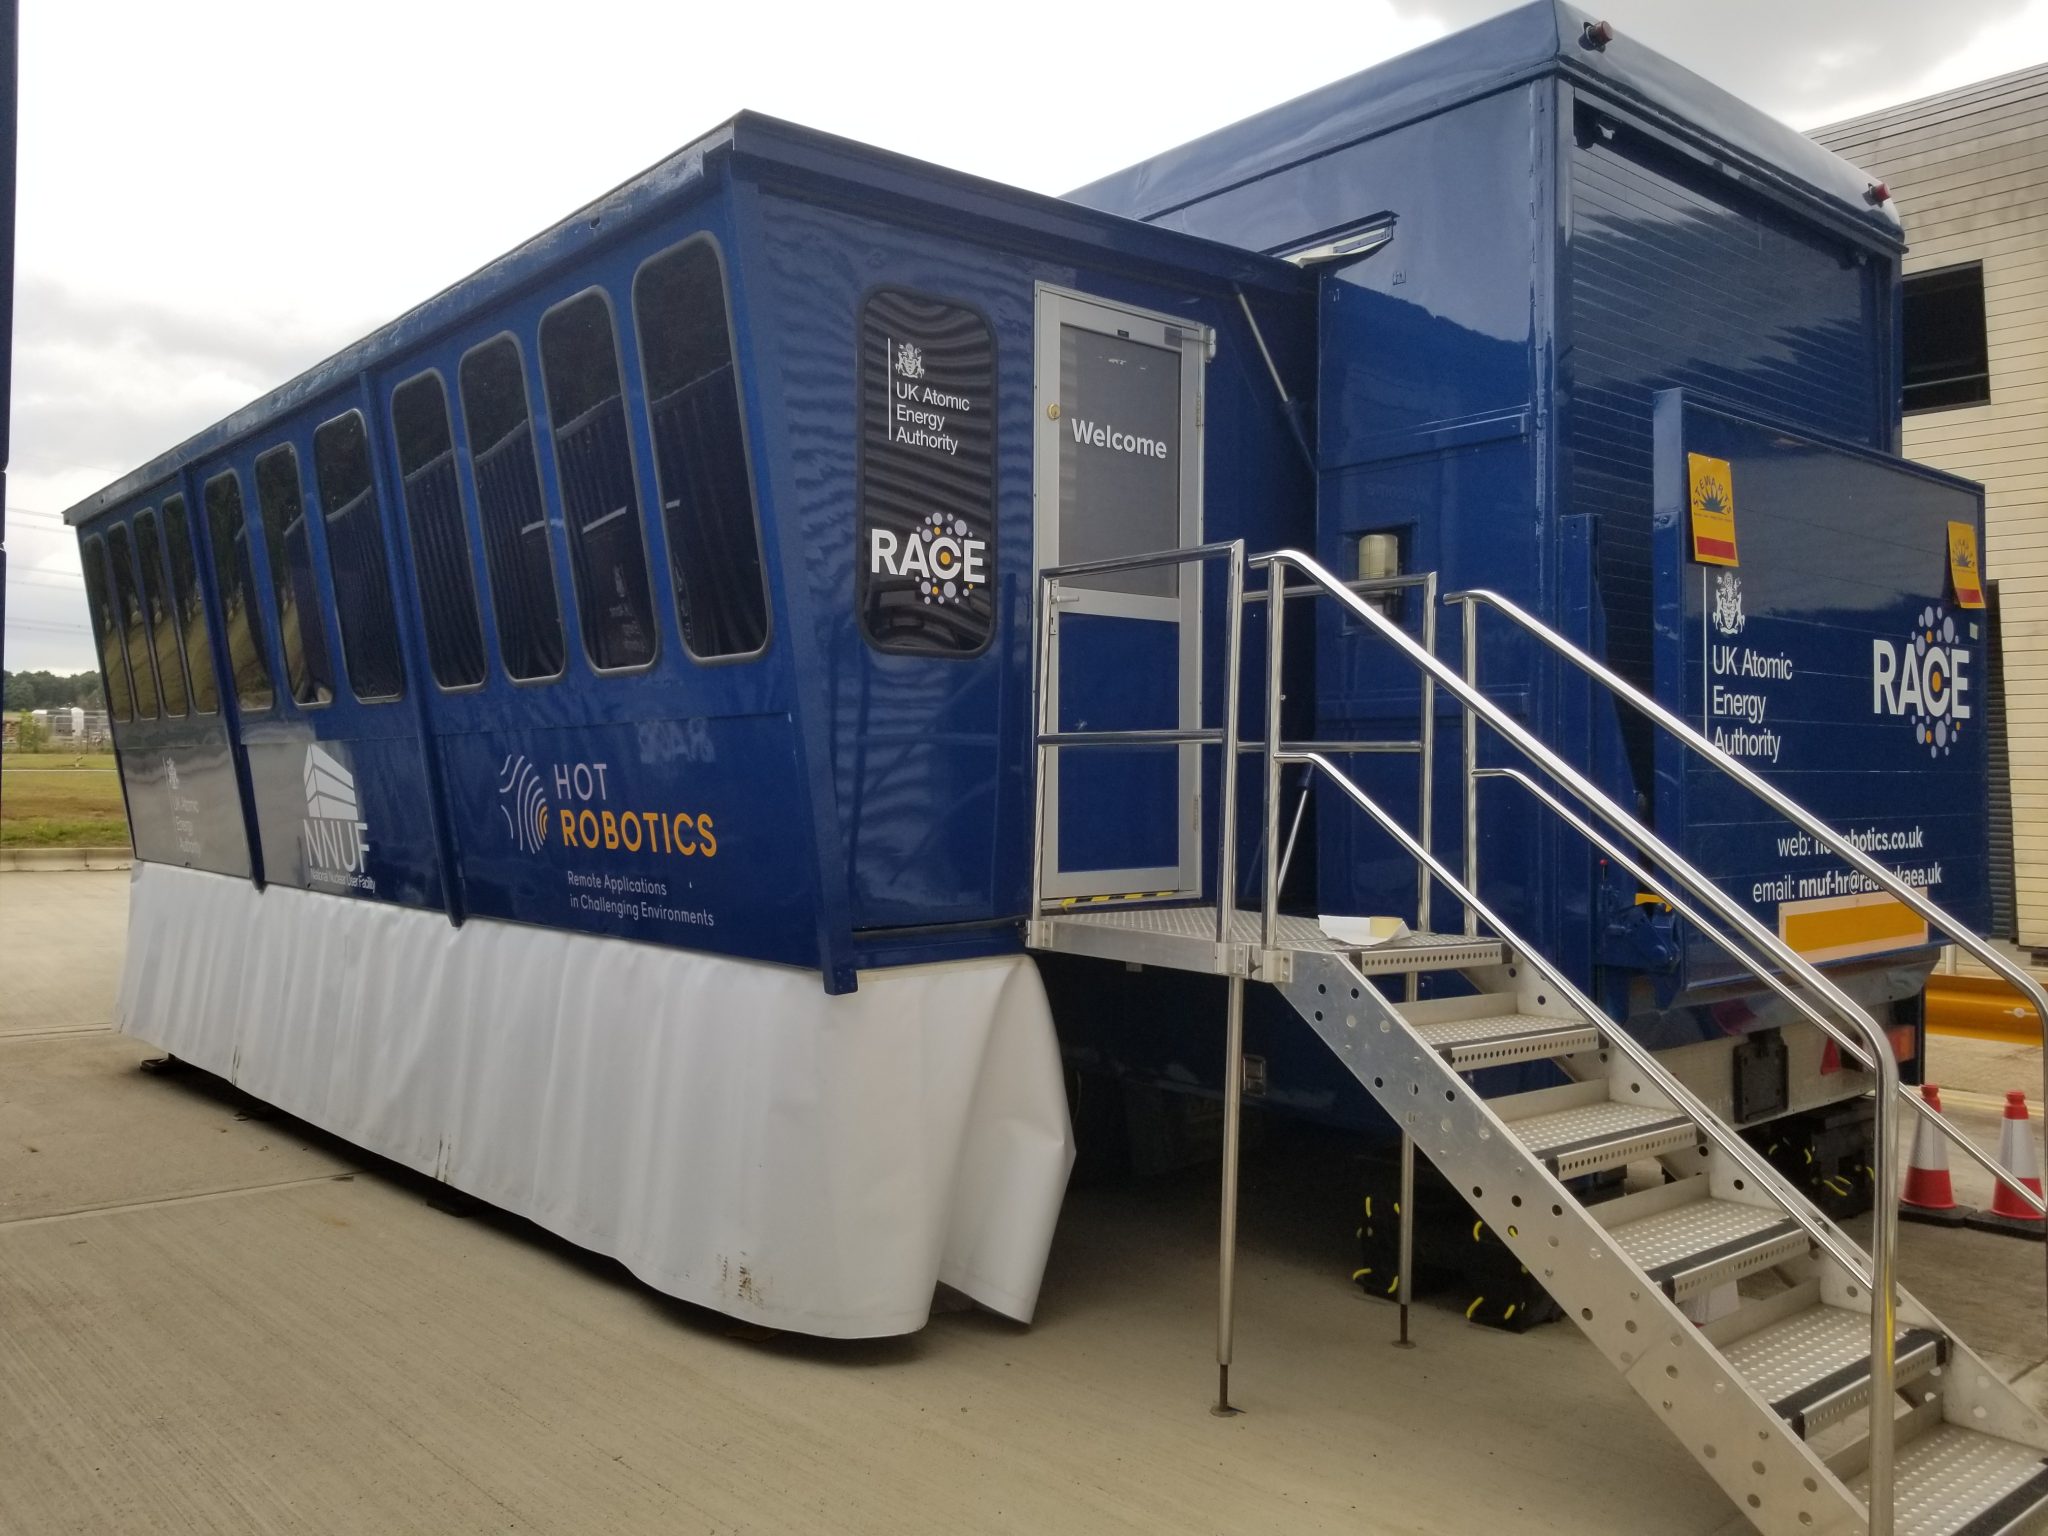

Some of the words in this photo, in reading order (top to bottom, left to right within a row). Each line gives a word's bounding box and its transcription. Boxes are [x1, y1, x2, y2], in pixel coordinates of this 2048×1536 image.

[896, 381, 918, 402] UK
[922, 386, 970, 412] Atomic
[896, 404, 945, 431] Energy
[896, 426, 958, 455] Authority
[1071, 418, 1167, 459] Welcome
[871, 528, 986, 584] RACE
[1712, 644, 1738, 676] UK
[1741, 647, 1793, 680] Atomic
[1873, 638, 1971, 719] RACE
[1713, 685, 1767, 724] Energy
[1713, 726, 1781, 763] Authority
[554, 763, 608, 801] HOT
[303, 818, 371, 874] NNUF
[560, 809, 718, 858] ROBOTICS
[1777, 831, 1811, 857] web:
[567, 870, 602, 889] Remote
[604, 873, 667, 896] Applications
[1752, 874, 1795, 903] email:
[1799, 862, 1942, 898] nnuf-hr@rackaea.uk
[570, 893, 579, 908] in
[580, 894, 639, 921] Challenging
[641, 901, 715, 927] Environments
